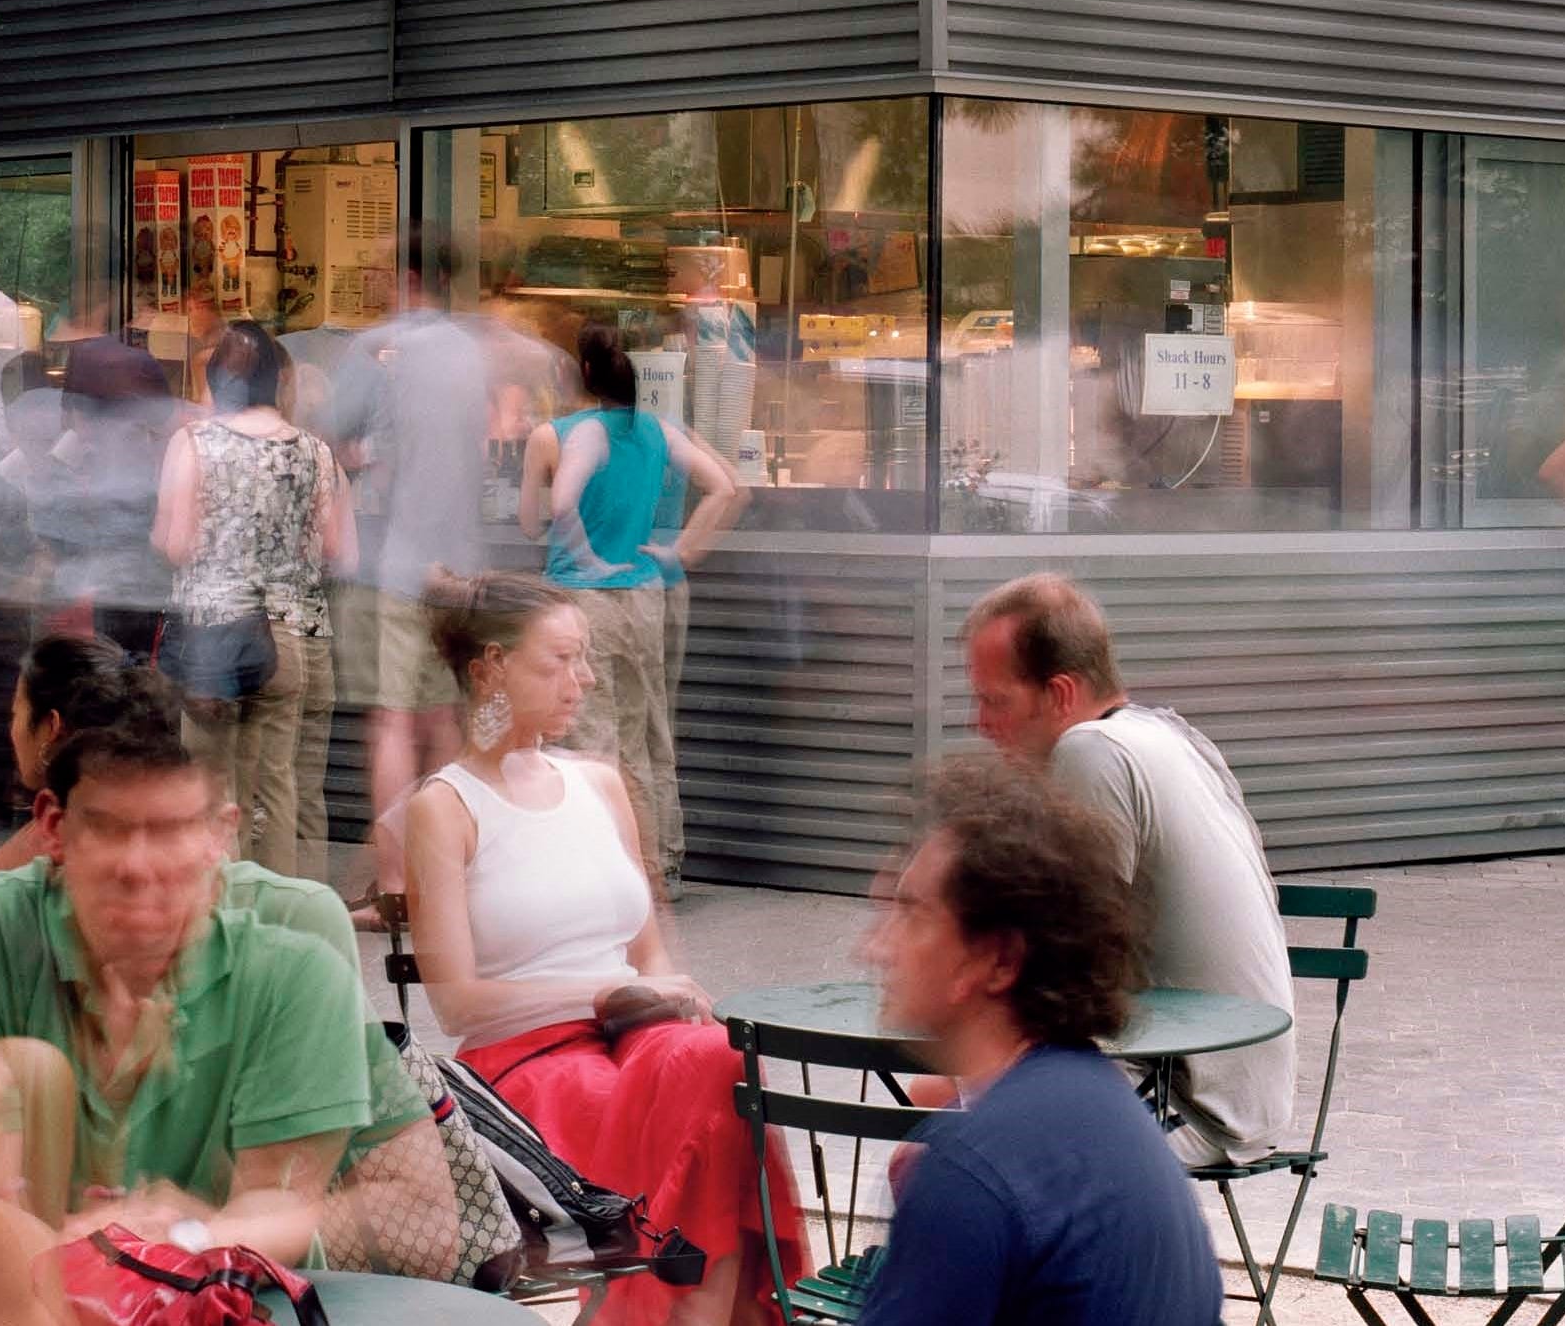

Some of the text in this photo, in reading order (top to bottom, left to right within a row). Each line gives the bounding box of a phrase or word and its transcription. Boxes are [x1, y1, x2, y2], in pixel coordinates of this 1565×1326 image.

[1157, 349, 1227, 365] Shack Hours
[643, 367, 675, 381] Hours
[1175, 372, 1188, 390] 11
[1202, 372, 1211, 390] 8
[650, 389, 659, 407] 8
